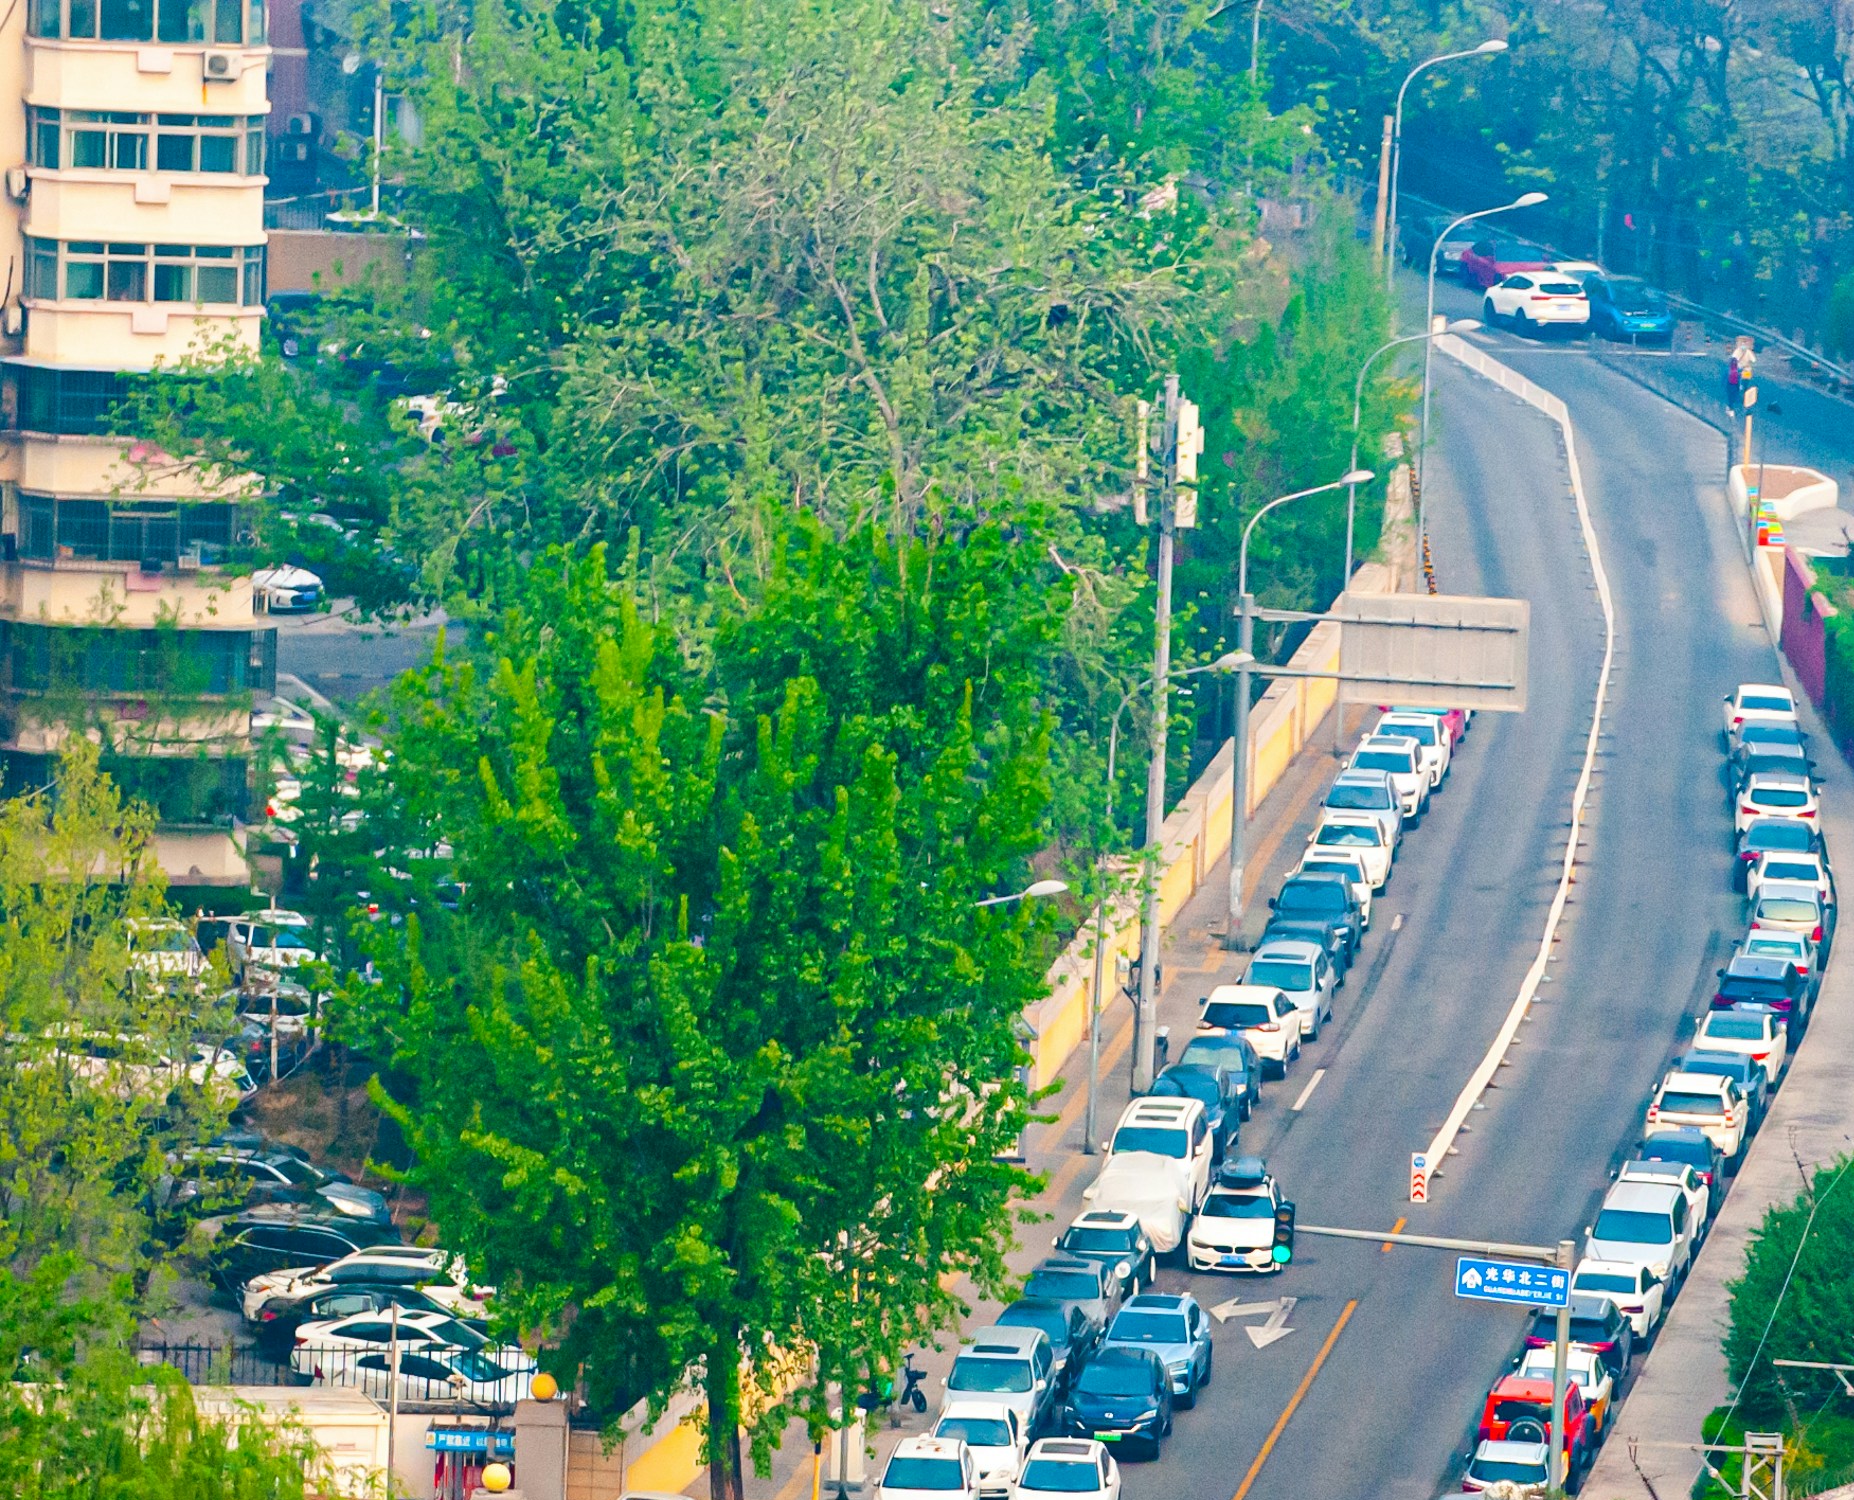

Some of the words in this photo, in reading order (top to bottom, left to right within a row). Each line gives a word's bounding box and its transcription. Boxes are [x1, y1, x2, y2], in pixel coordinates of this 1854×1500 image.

[1485, 1266, 1565, 1289] 光华北二街
